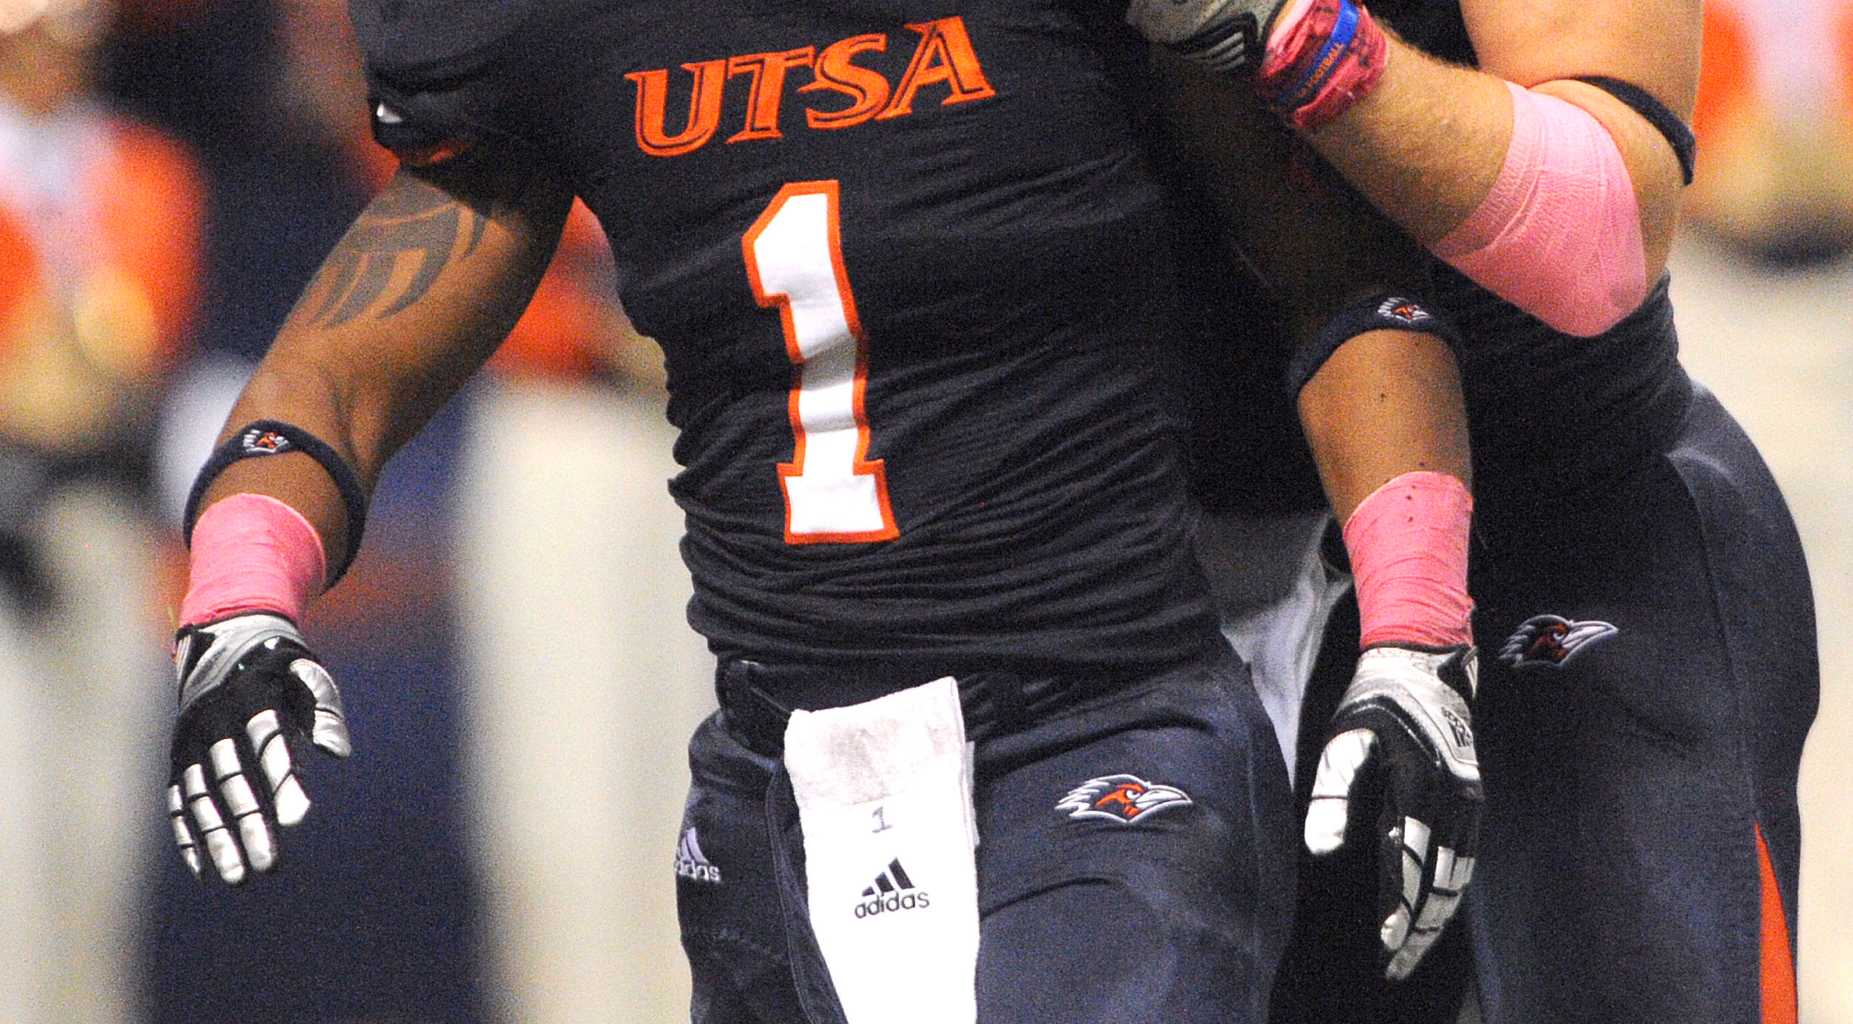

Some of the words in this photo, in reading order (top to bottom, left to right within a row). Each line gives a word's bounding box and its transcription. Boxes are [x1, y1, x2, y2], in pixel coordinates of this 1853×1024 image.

[623, 15, 997, 157] UTSA
[741, 179, 900, 545] 1
[871, 806, 893, 833] 1
[854, 891, 930, 919] adidas
